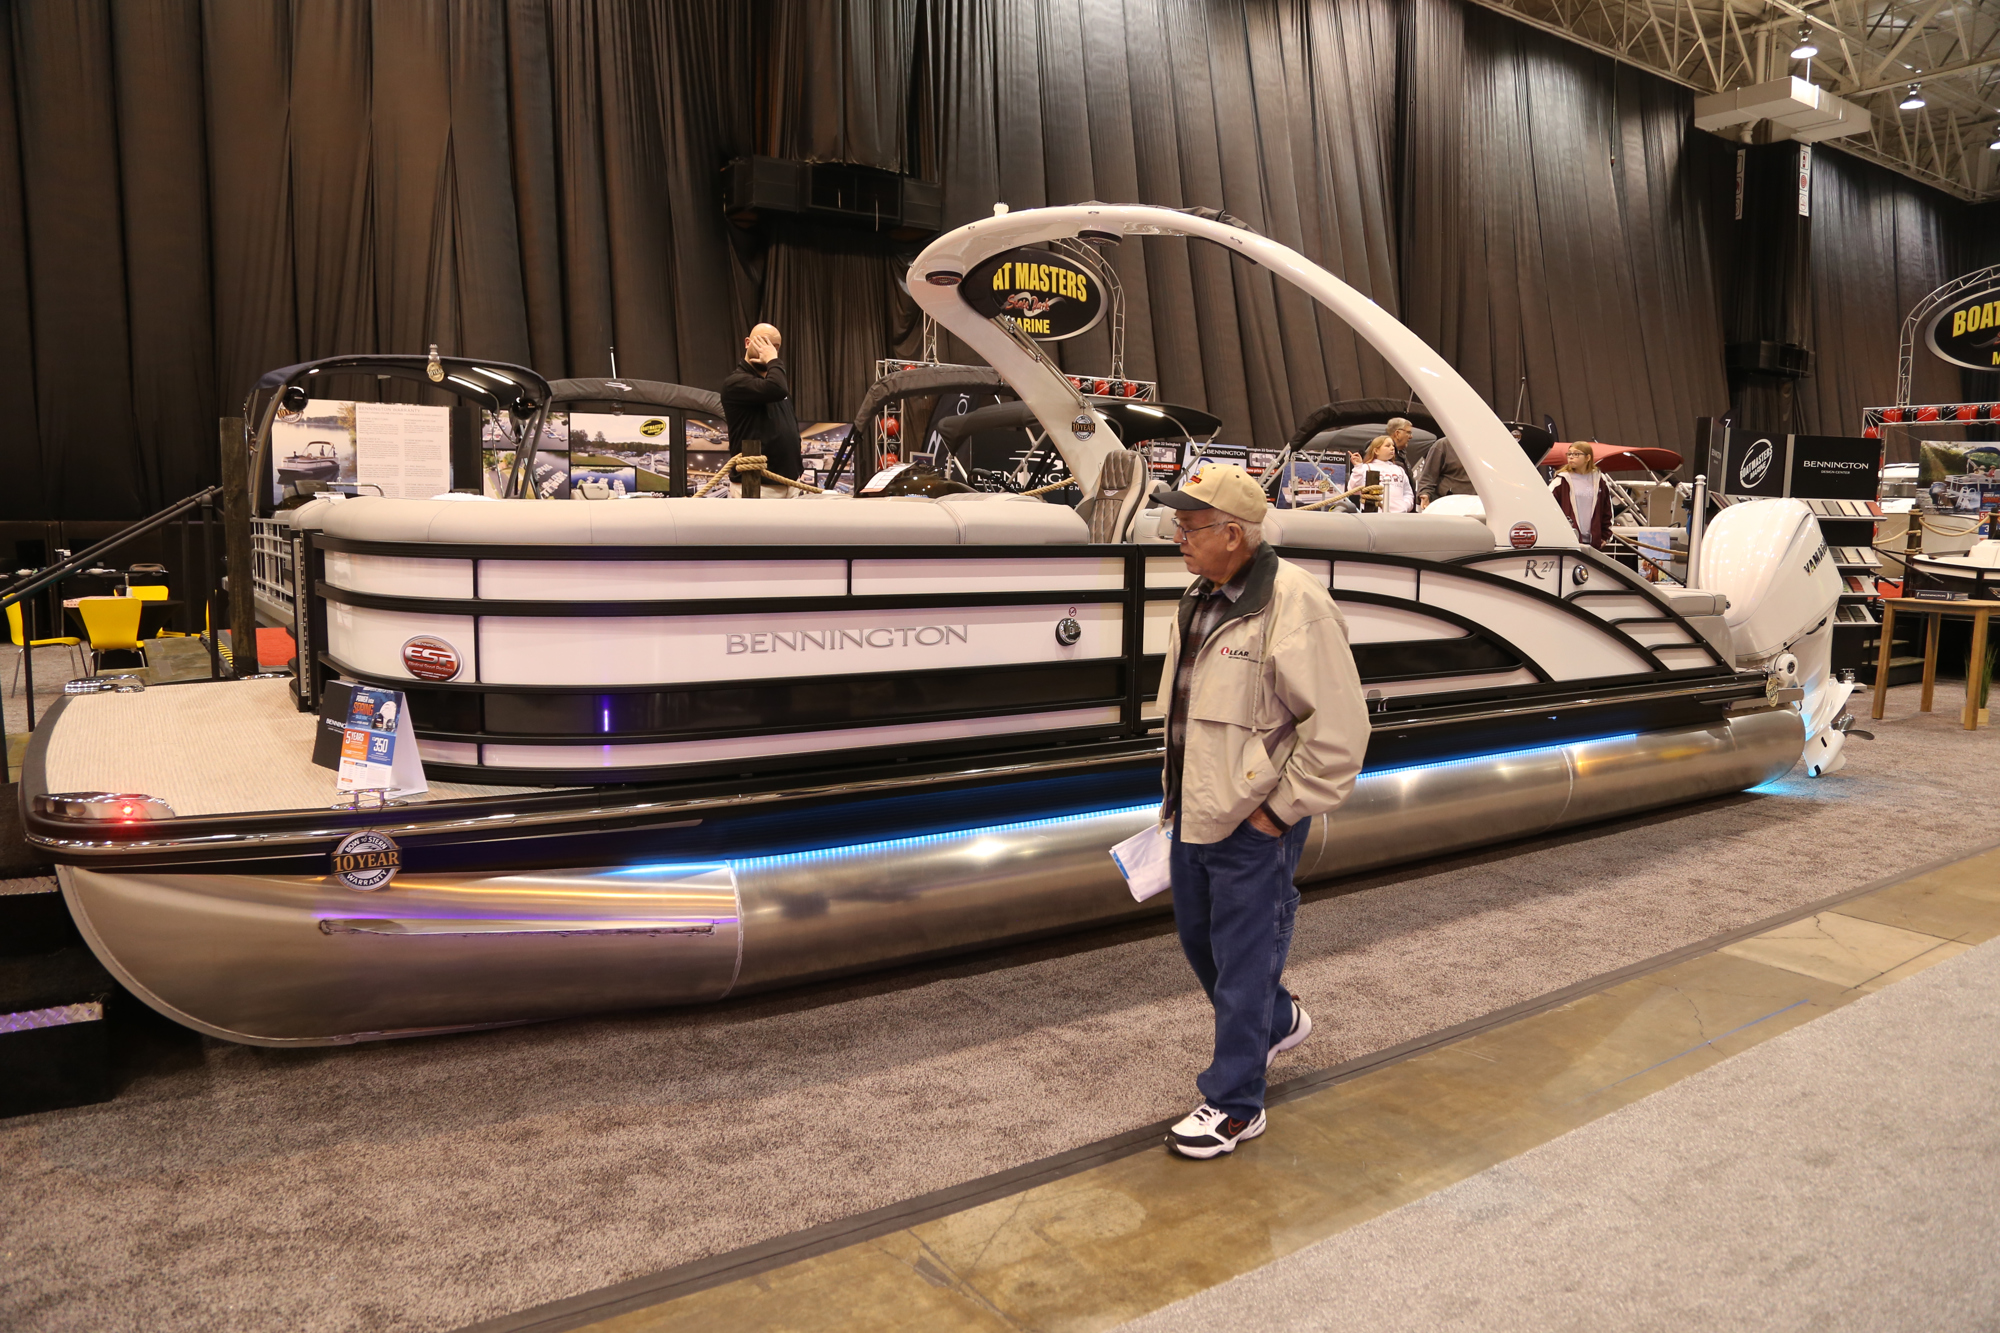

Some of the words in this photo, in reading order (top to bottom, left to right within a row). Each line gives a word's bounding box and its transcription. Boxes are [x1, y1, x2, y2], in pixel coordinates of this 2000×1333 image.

[992, 262, 1012, 291] AT
[1015, 262, 1087, 302] MASTERS
[1016, 317, 1051, 334] ARINE
[1952, 300, 2000, 338] BOAT
[1206, 449, 1246, 457] BENNINGTON
[1740, 445, 1773, 480] BOATMASTERS
[1803, 460, 1869, 469] BENNINGTON
[1511, 530, 1535, 539] ESP
[1803, 536, 1828, 577] YAMAH
[1525, 559, 1545, 580] R
[1541, 561, 1555, 573] 27
[415, 641, 445, 649] BENNINGTON
[726, 624, 969, 655] BENNINGTON
[405, 646, 457, 666] ESP
[353, 701, 375, 716] SPRING
[326, 717, 347, 730] BENNING
[345, 731, 351, 744] 5
[350, 731, 365, 742] YEARS
[345, 838, 360, 852] BOW
[368, 836, 388, 850] STERN
[333, 855, 355, 872] 10
[356, 851, 400, 868] YEAR
[347, 869, 387, 886] WARRANTY
